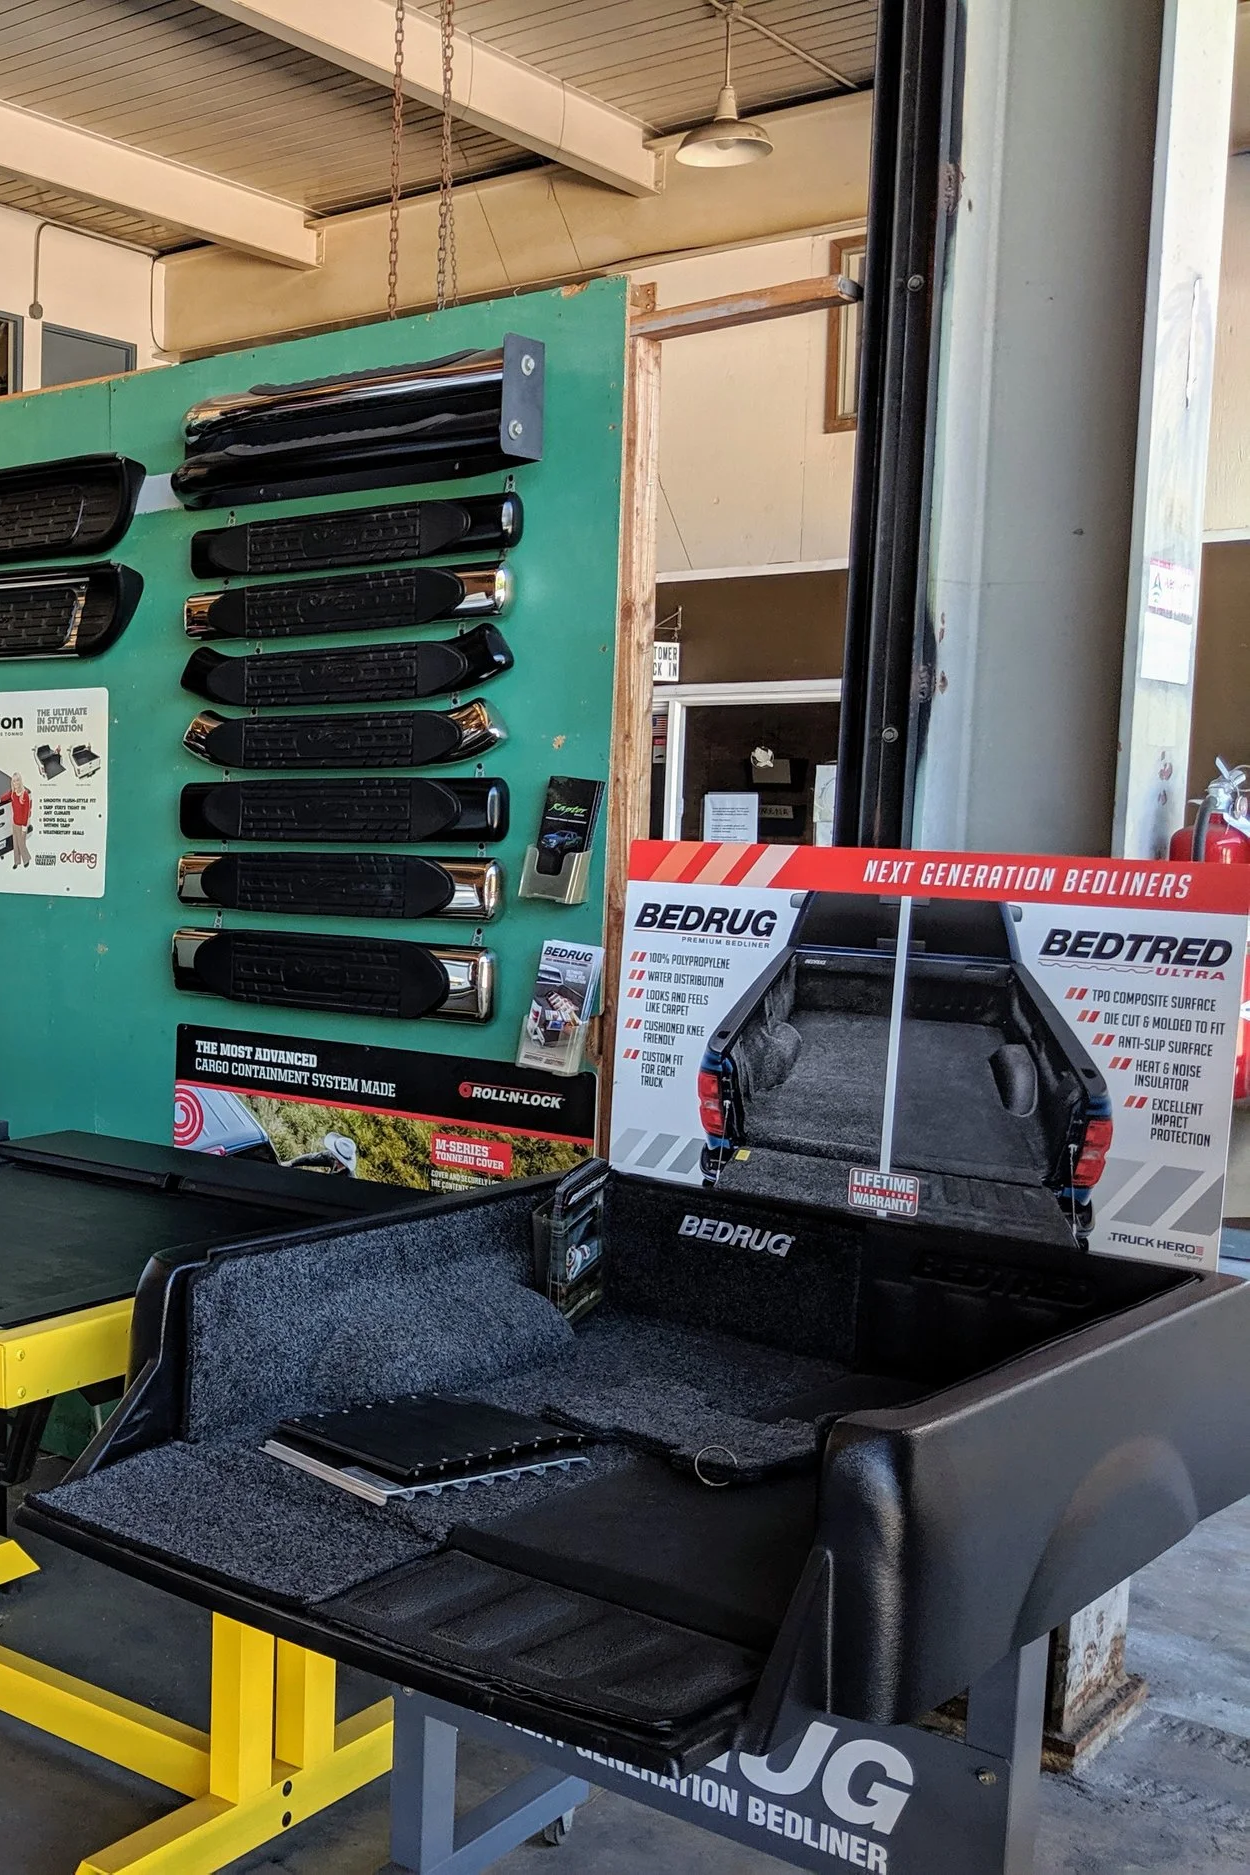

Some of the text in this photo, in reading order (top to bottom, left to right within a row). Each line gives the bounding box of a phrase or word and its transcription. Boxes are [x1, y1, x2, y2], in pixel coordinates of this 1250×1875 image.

[669, 662, 677, 677] IN
[36, 707, 89, 717] THE ULTIMATE
[36, 715, 78, 725] IN STYLE &
[36, 724, 84, 733] INNOVATION
[59, 848, 98, 870] extang
[863, 859, 1193, 899] NEXT GENERATION BEDLINERS
[634, 902, 777, 938] BEDRUG
[681, 936, 770, 949] PREMIUM BEDLINER
[1038, 928, 1233, 968] BEDTRED
[544, 946, 593, 962] BEDRUG
[649, 952, 730, 969] 100% POLYPROPYLENE
[647, 971, 724, 988] WATER DISTRIBUTION
[1155, 967, 1226, 981] ULTRA
[646, 989, 709, 1006] LOOKS AND FEELS
[1092, 989, 1217, 1012] TPO COMPOSITE SURFACE
[645, 1001, 689, 1016] LIKE CARPET
[644, 1020, 705, 1037] CUSHIONED KNEE
[1104, 1012, 1226, 1036] DIE CUT & MOLDED TO FIT
[643, 1032, 675, 1046] FRIENDLY
[1118, 1035, 1213, 1057] ANTI-SLIP SURFACE
[195, 1040, 318, 1068] THE MOST ADVANCED
[642, 1050, 683, 1066] CUSTOM FIT
[195, 1057, 396, 1098] CARGO CONTAINMENT SYSTEM MADE
[641, 1063, 676, 1077] FOR EACH
[1135, 1059, 1202, 1078] HEAT & NOISE
[640, 1075, 664, 1088] TRUCK
[1134, 1074, 1189, 1092] INSULATOR
[1151, 1098, 1204, 1116] EXCELLENT
[1151, 1113, 1189, 1129] IMPACT
[1150, 1127, 1211, 1147] PROTECTION
[435, 1138, 490, 1158] M-SERIES
[435, 1151, 504, 1171] TONNEAU COVER
[431, 1169, 449, 1179] COVER
[450, 1172, 461, 1181] AND
[461, 1174, 488, 1187] SECURELY
[431, 1179, 442, 1188] THE
[853, 1171, 915, 1194] LIFETIME
[852, 1186, 880, 1195] ULTRA
[852, 1192, 913, 1213] WARRANTY
[677, 1214, 793, 1258] BEDRUG
[1110, 1231, 1196, 1254] TRUCK HERO
[1173, 1252, 1203, 1263] company
[706, 1720, 914, 1835] UG
[747, 1795, 888, 1875] BEDLINER
